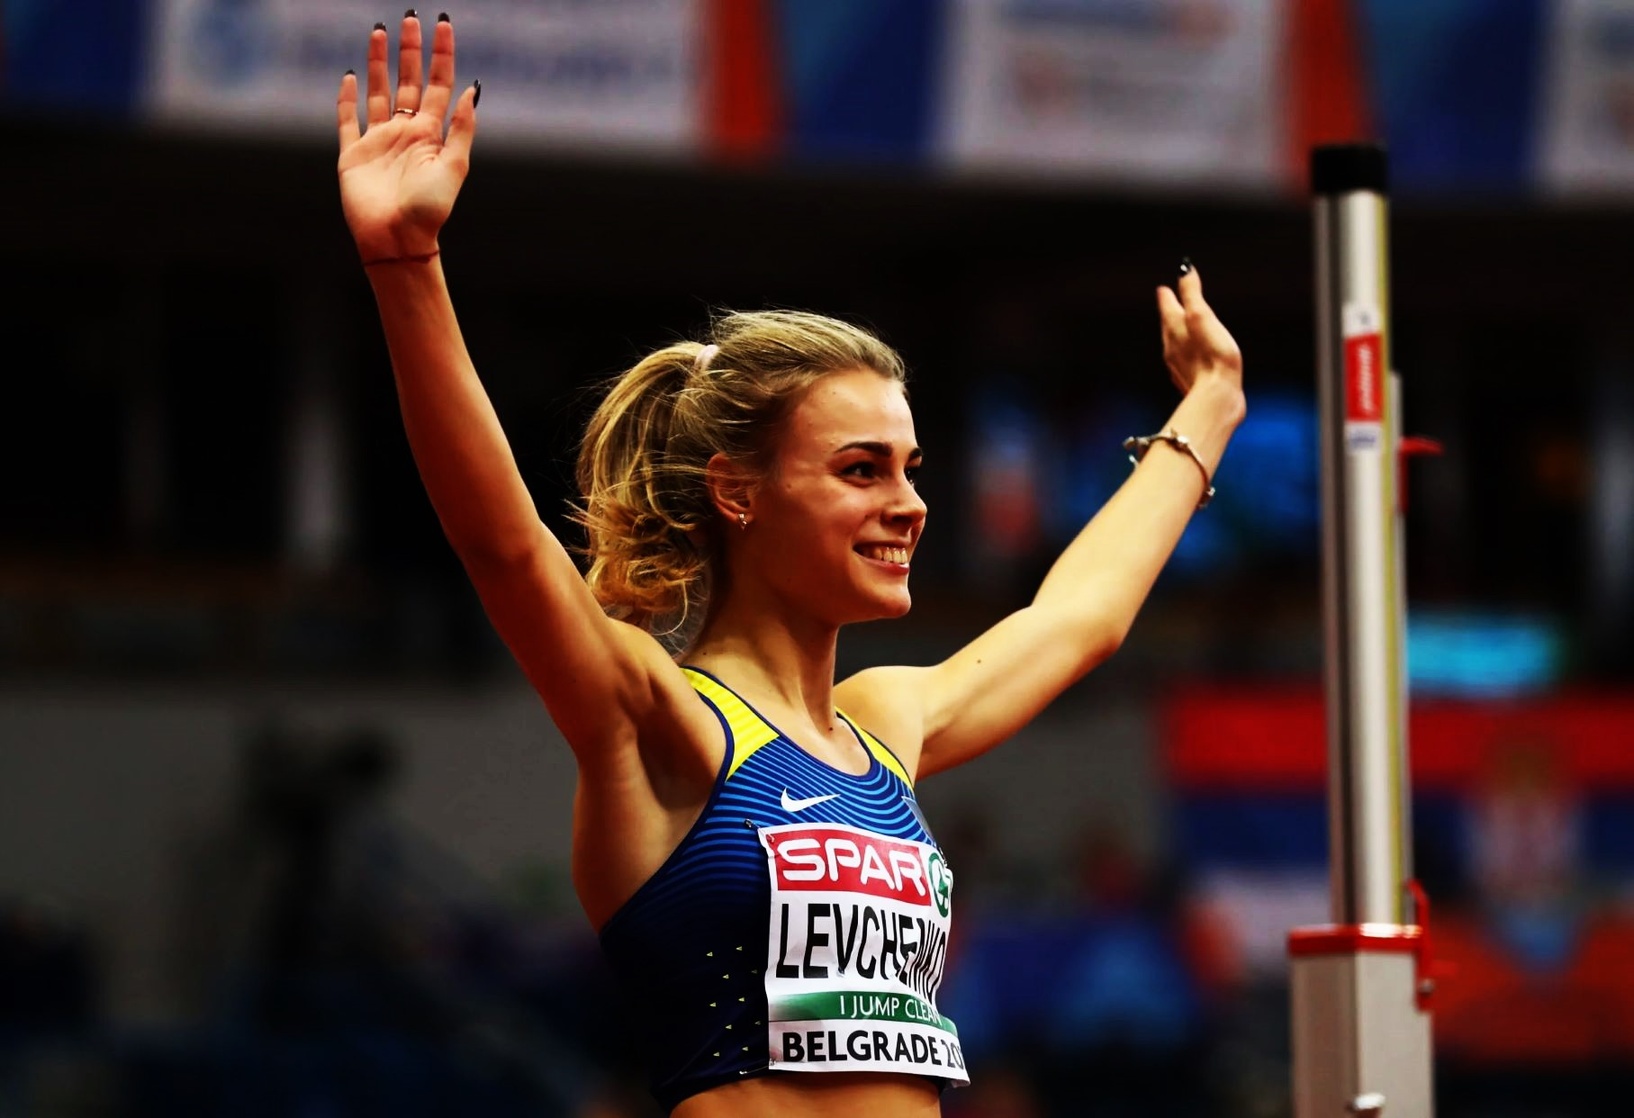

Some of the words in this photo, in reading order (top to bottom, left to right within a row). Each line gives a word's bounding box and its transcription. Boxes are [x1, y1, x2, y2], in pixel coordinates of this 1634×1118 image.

[777, 838, 926, 896] SPAR
[840, 995, 846, 1015] I
[851, 995, 900, 1018] JUMP
[904, 998, 942, 1025] CLEAN
[782, 1029, 942, 1066] BELGRADE
[941, 1039, 964, 1070] 20
